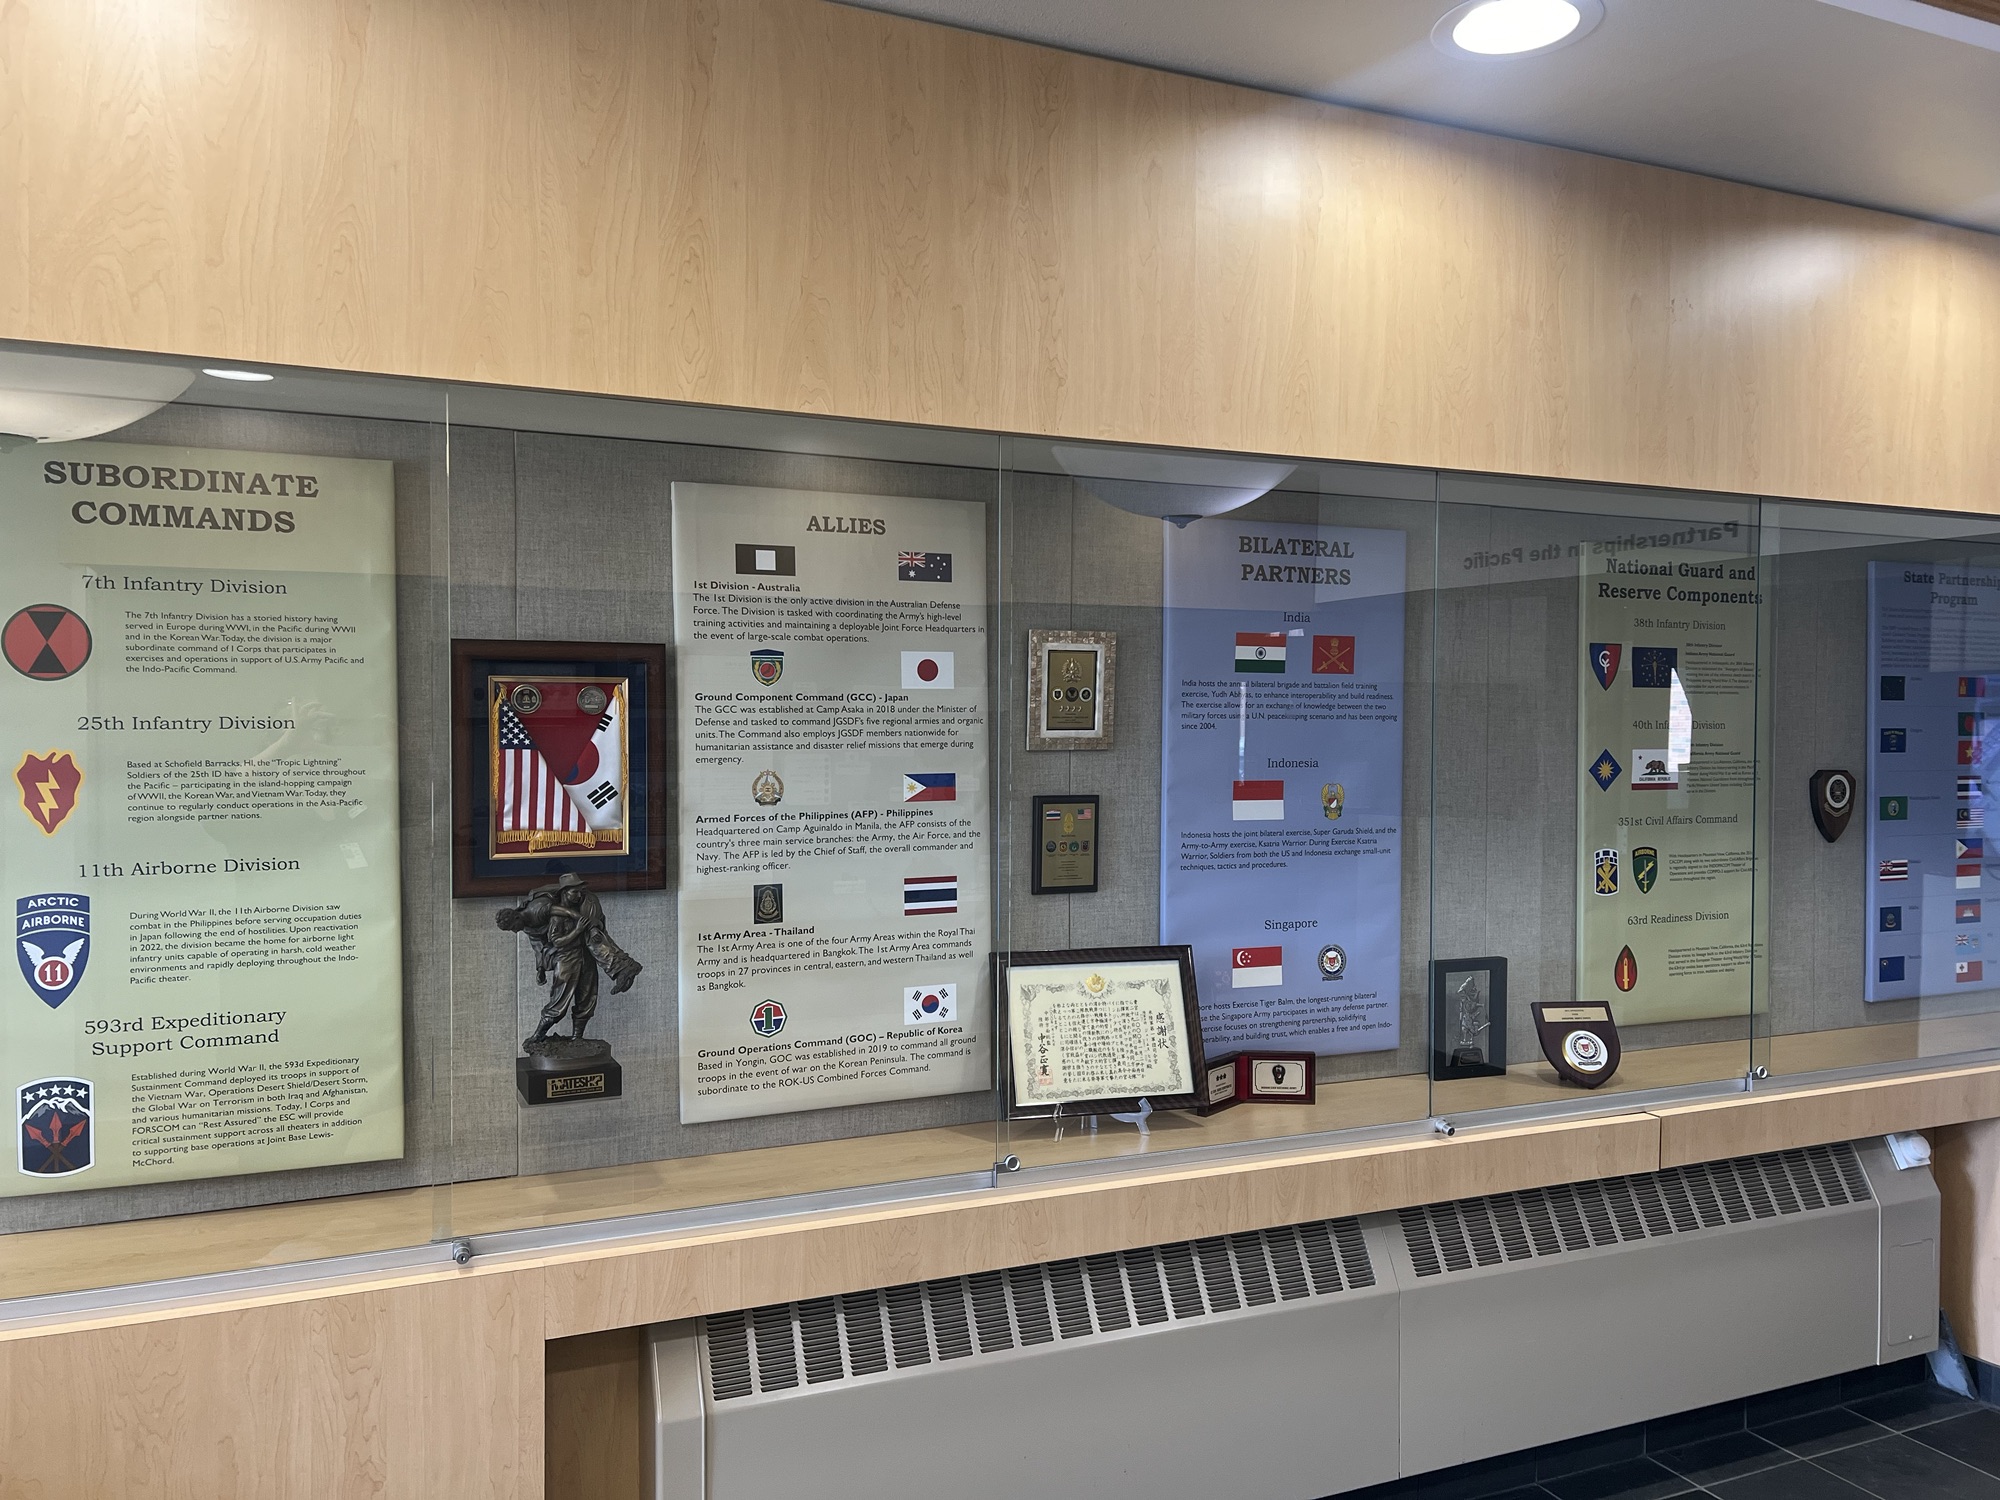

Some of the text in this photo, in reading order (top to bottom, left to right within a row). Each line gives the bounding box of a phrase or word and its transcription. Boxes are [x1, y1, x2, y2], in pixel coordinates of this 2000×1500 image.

[43, 460, 319, 498] SUBORDINATE
[71, 500, 296, 534] COMMANDS
[805, 515, 886, 536] ALLIES
[1238, 535, 1355, 559] BILATERAL
[1240, 563, 1351, 586] PARTNERS
[1606, 557, 1756, 582] National Guard and
[1903, 570, 1935, 585] State
[81, 574, 287, 596] 7th Infantry Division
[693, 580, 801, 592] 1st Division Australia
[1597, 582, 1764, 607] Reserve Components
[1929, 591, 1978, 608] Program
[124, 610, 142, 619] The
[144, 611, 159, 619] 7th
[160, 611, 193, 622] Infantry
[195, 612, 229, 621] Division
[230, 613, 245, 621] has
[253, 614, 282, 626] storied
[284, 614, 312, 626] history
[313, 615, 339, 625] having
[1283, 611, 1311, 623] India
[1633, 617, 1726, 632] 38th Infantry Division
[693, 630, 708, 640] the
[747, 631, 791, 643] large-scale
[793, 632, 824, 642] combat
[825, 631, 869, 644] operations.
[125, 664, 237, 674] the Indo-Pacific Command.
[694, 692, 909, 704] Ground Component Command (GCC) Japan
[77, 715, 295, 734] 25th Infantry Division
[1180, 721, 1217, 730] since 2004.
[1632, 719, 1653, 730] 40th
[1692, 720, 1727, 730] Division
[126, 760, 152, 769] Based
[164, 759, 202, 768] Schofield
[243, 759, 256, 767] HI,
[256, 759, 270, 767] the
[694, 756, 744, 766] emergency.
[1267, 757, 1319, 768] Indonesia
[127, 815, 155, 824] region
[156, 813, 195, 823] alongside
[197, 813, 229, 822] partner
[695, 814, 731, 824] Armed
[733, 813, 766, 823] Forces
[780, 812, 796, 821] the
[798, 811, 849, 822] Philippines
[850, 809, 878, 821] (AFP)
[886, 808, 933, 819] Philippines
[1617, 813, 1738, 827] 351st Civil Affairs Command
[79, 857, 300, 878] 11th Airborne Division
[696, 861, 791, 876] highest-ranking officer.
[1216, 862, 1237, 870] tactics
[1238, 861, 1251, 869] and
[27, 896, 79, 909] ARCTIC
[22, 915, 85, 929] AIRBORNE
[1264, 919, 1318, 932] Singapore
[1627, 910, 1729, 926] 63rd Readiness Division
[698, 925, 815, 942] 1st Army Area Thailand
[44, 964, 63, 983] 11
[129, 975, 191, 985] Pacific theater.
[708, 979, 746, 992] Bangkok.
[1213, 1002, 1231, 1010] hosts
[1232, 1000, 1259, 1009] Exercise
[1259, 999, 1276, 1009] Tiger
[1295, 996, 1307, 1005] the
[1307, 994, 1353, 1005] longest-running
[1353, 991, 1377, 1000] bilateral
[84, 1010, 286, 1035] 593rd Expeditionary
[1155, 1012, 1169, 1049] 感謝状
[91, 1028, 279, 1058] Support Command
[697, 1046, 735, 1058] Ground
[737, 1042, 792, 1056] Operations
[793, 1035, 843, 1049] Command
[845, 1032, 877, 1046] (GOC)
[886, 1028, 924, 1041] Republic
[937, 1026, 963, 1035] Korea
[131, 1070, 177, 1082] Established
[179, 1069, 206, 1078] during
[207, 1065, 236, 1075] World
[237, 1064, 257, 1072] War
[268, 1062, 282, 1071] the
[284, 1060, 304, 1069] 593d
[306, 1057, 360, 1068] Expeditionary
[697, 1084, 748, 1096] subordinate
[762, 1080, 776, 1090] the
[778, 1075, 815, 1088] ROK-US
[816, 1070, 859, 1084] Combined
[860, 1069, 887, 1079] Forces
[888, 1063, 931, 1076] Command.
[132, 1156, 174, 1167] McChord.
